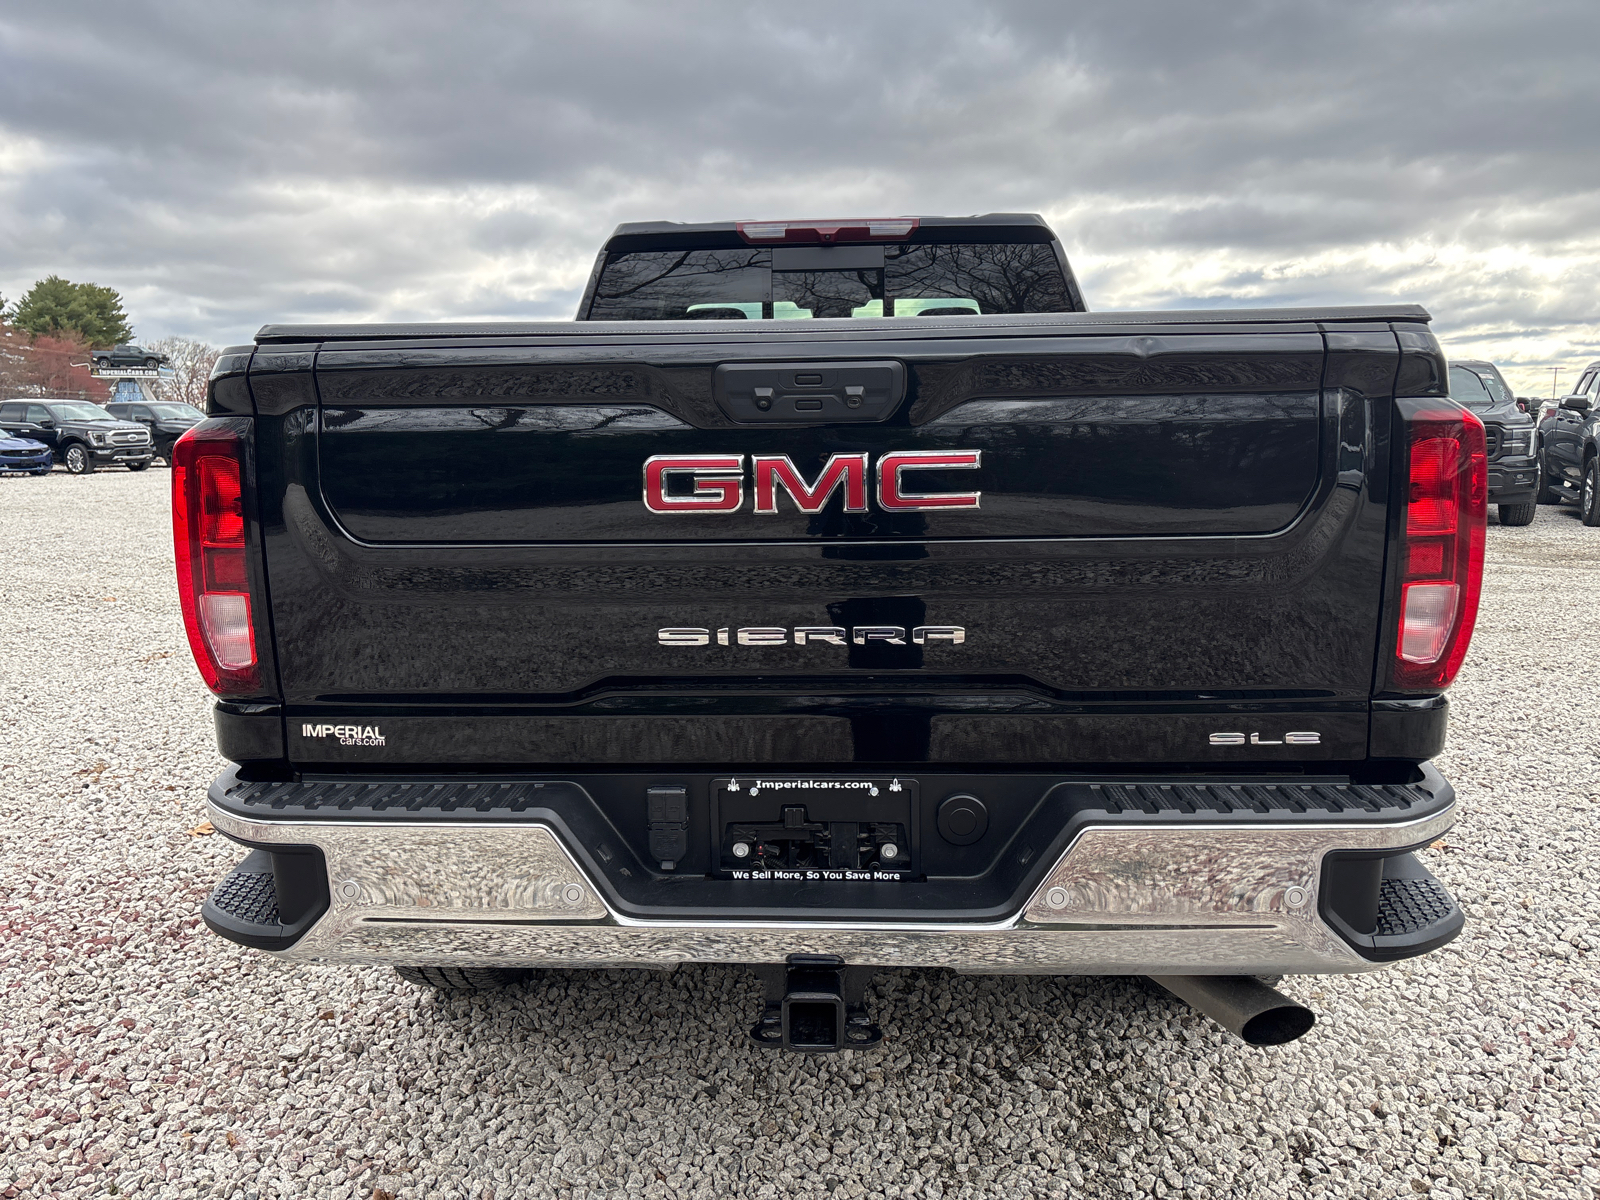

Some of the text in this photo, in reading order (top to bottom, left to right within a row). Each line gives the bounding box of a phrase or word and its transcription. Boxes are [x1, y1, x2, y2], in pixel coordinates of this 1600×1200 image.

[643, 449, 982, 515] GMC
[658, 625, 966, 646] SIERRA
[302, 724, 386, 739] IMPERIAL
[1209, 731, 1321, 745] SLE
[339, 737, 386, 747] cars.com
[755, 780, 873, 790] Imperialcars.com
[732, 871, 900, 881] We Sell More, So You Save More
